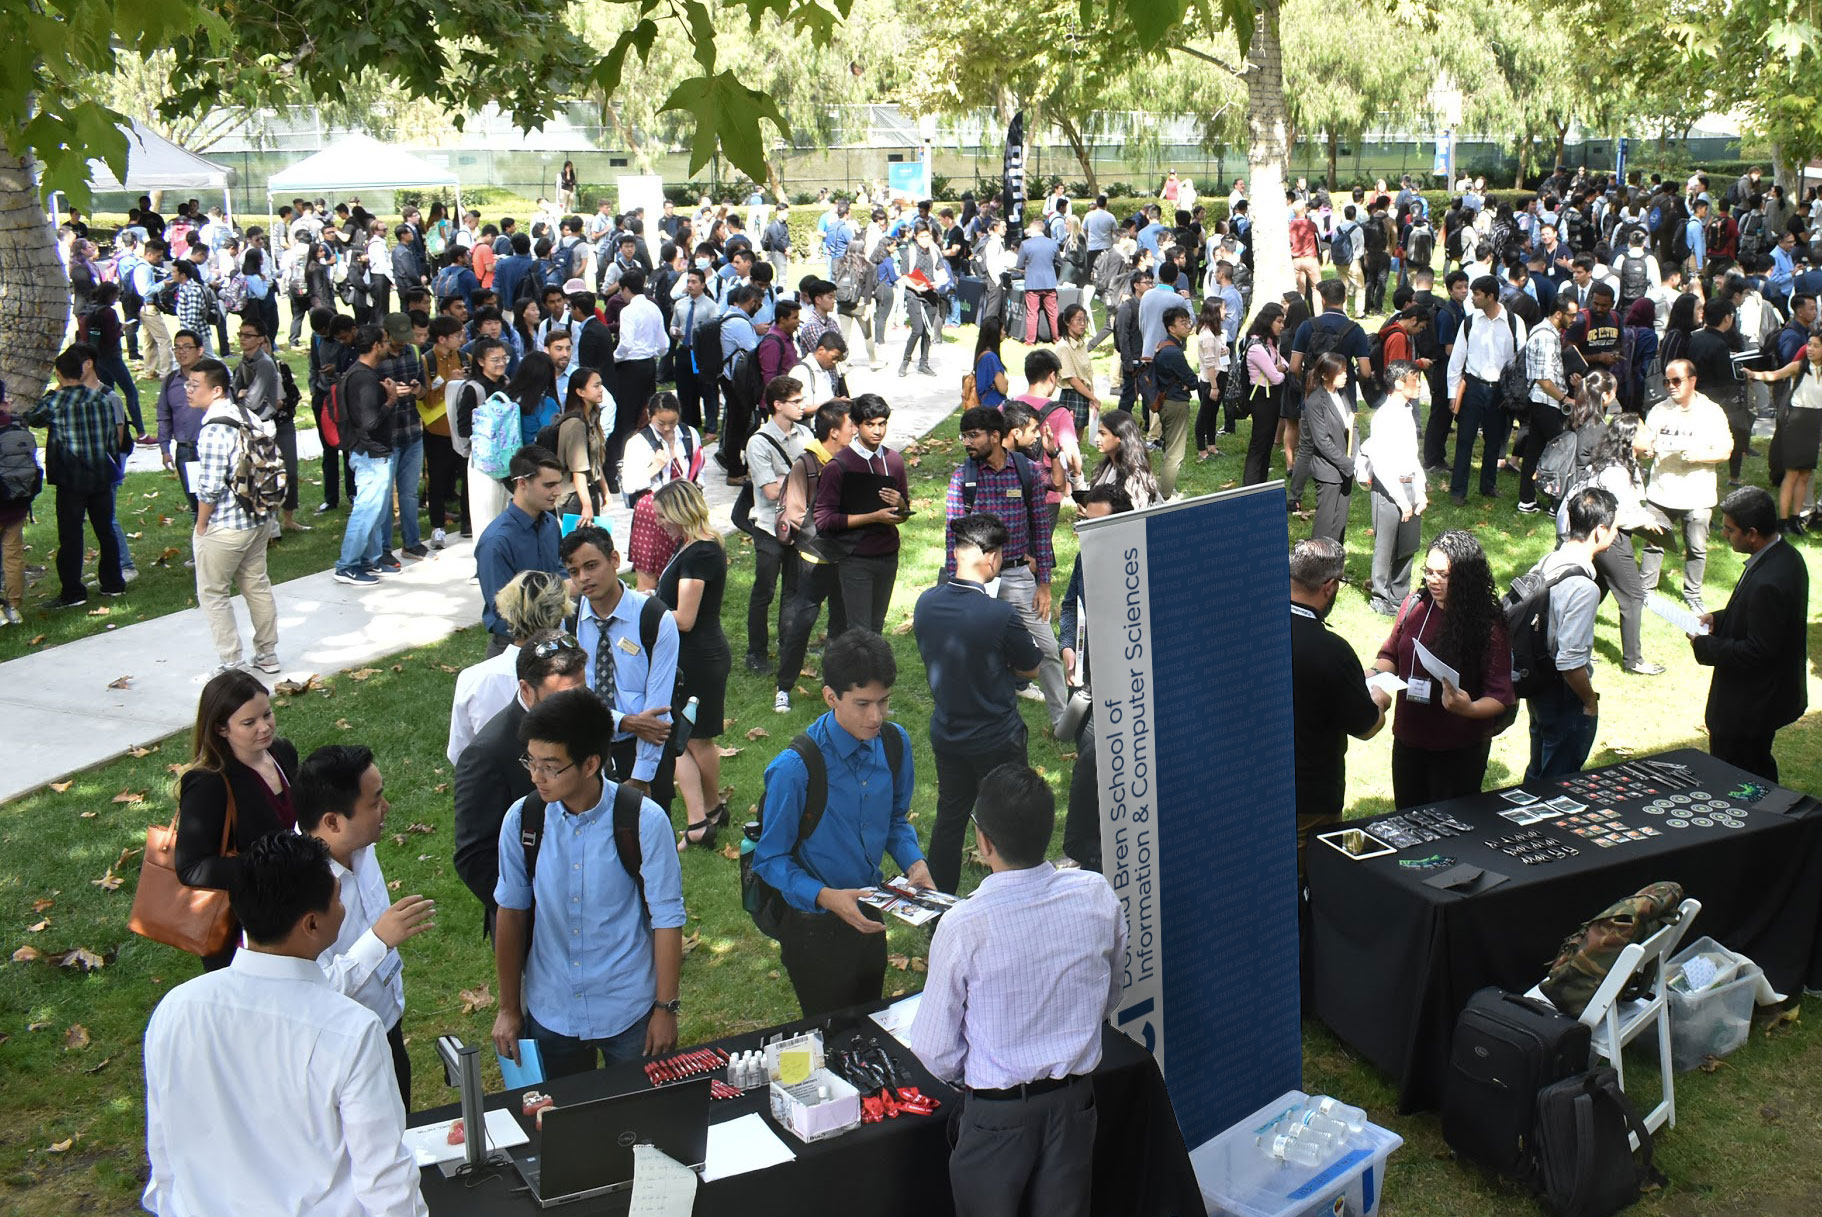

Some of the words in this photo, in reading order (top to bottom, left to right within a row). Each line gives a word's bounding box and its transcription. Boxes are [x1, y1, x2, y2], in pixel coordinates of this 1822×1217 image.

[960, 298, 971, 312] ulu
[1124, 547, 1143, 660] Sciences
[1105, 699, 1123, 724] of
[1129, 668, 1149, 798] Computer
[1105, 732, 1127, 822] School
[1132, 803, 1149, 824] &
[1114, 827, 1130, 890] Bren
[1135, 830, 1154, 982] Information
